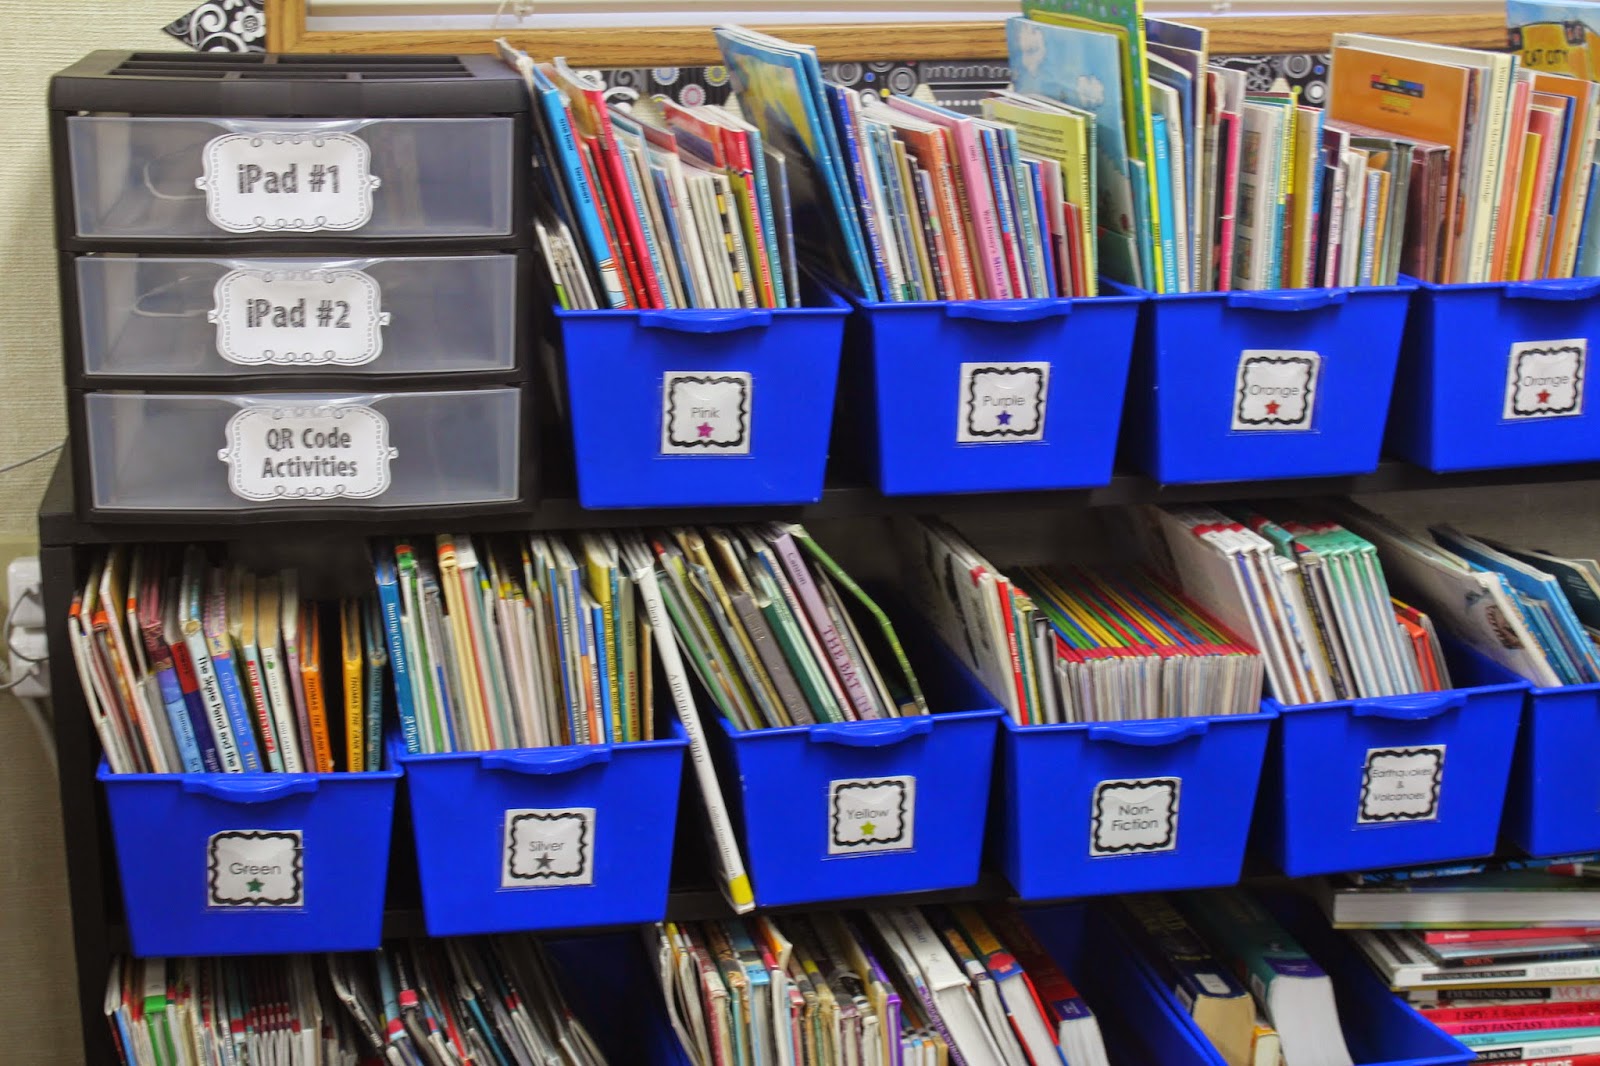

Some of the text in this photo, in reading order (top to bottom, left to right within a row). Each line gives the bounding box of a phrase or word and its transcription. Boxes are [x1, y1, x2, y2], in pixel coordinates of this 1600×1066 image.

[237, 163, 341, 194] iPad #1
[245, 298, 351, 329] iPad #2
[982, 395, 1026, 408] Purple
[1249, 384, 1300, 399] Orange
[691, 406, 721, 419] Pink
[266, 427, 352, 452] QR Code
[261, 457, 358, 479] Activities
[786, 551, 809, 586] Cannon
[647, 597, 663, 629] Cherry
[821, 624, 847, 661] THE
[838, 660, 862, 692] BAT
[308, 677, 318, 711] THOMAS
[349, 676, 360, 709] THOMAS
[198, 656, 238, 767] The Skate Patrol and the
[313, 714, 321, 728] THE
[352, 712, 360, 726] THE
[669, 672, 704, 764] A RIVER RAN WILD
[315, 731, 325, 751] TANK
[351, 729, 362, 750] TANK
[846, 808, 890, 820] Yellow
[1119, 805, 1155, 816] Non-
[1111, 819, 1159, 831] Fiction
[528, 840, 565, 852] Silver
[229, 862, 281, 875] Green
